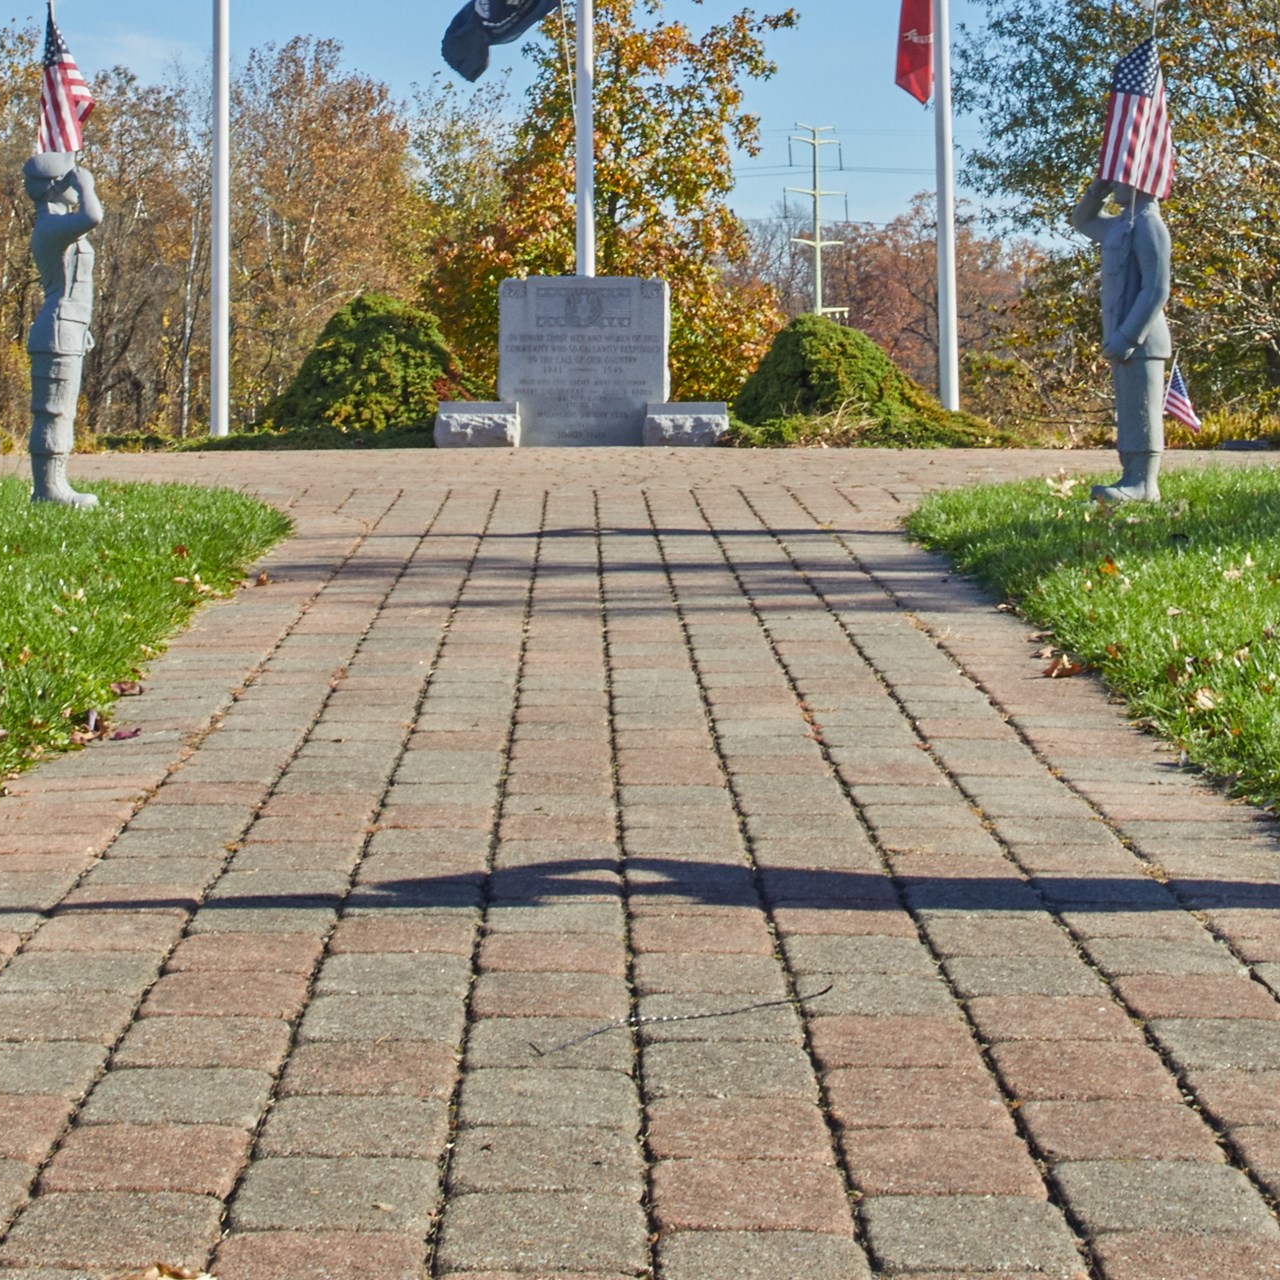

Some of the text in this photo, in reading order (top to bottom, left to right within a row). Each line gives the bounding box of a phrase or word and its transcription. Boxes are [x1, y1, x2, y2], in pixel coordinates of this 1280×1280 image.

[520, 334, 544, 342] HONOR
[546, 334, 567, 342] THOSE
[570, 334, 586, 342] MEN
[588, 334, 602, 342] AND
[604, 334, 630, 342] WOMEN
[632, 334, 640, 342] OF
